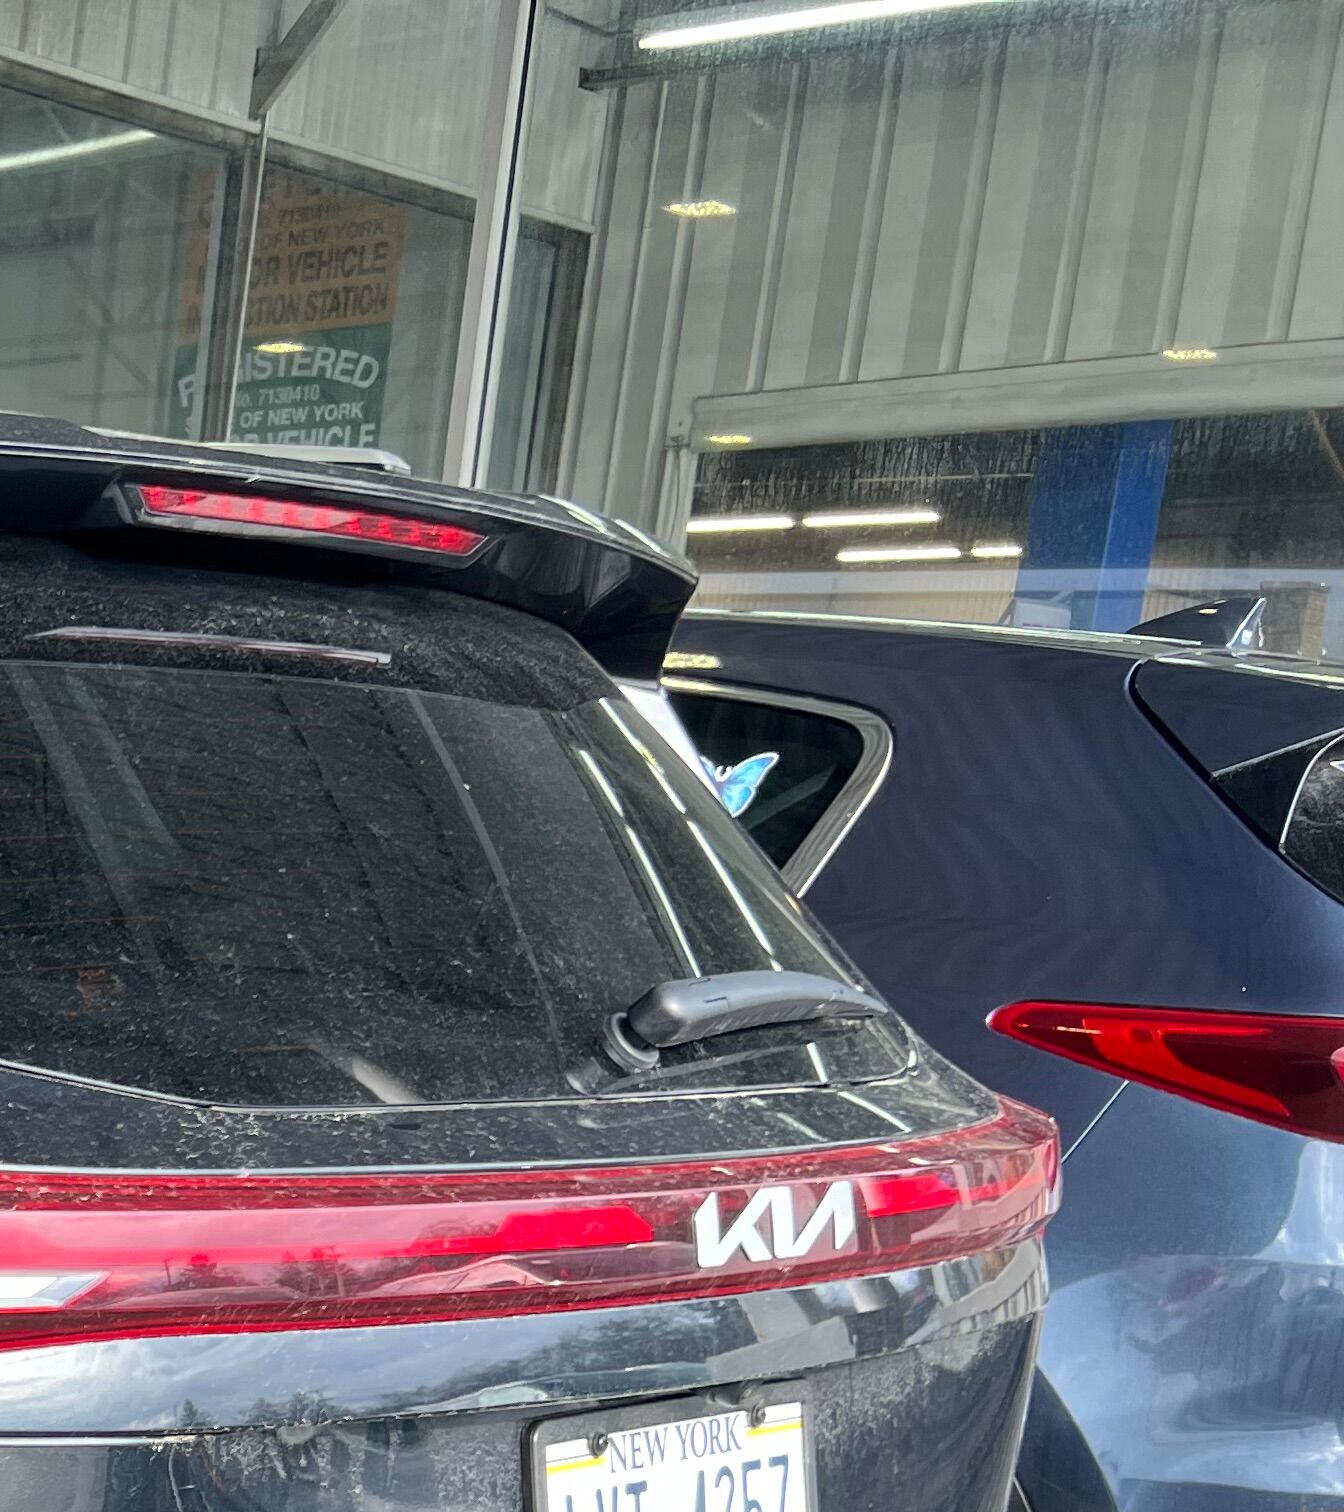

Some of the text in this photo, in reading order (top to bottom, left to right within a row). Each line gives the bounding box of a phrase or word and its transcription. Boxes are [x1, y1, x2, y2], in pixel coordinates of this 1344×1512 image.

[288, 228, 328, 247] NEW
[334, 220, 385, 241] YORK
[287, 242, 389, 285] VEHICLE
[304, 283, 390, 322] STATION
[239, 401, 366, 429] OF NEW YORK
[693, 1180, 857, 1269] KIA
[609, 1414, 742, 1474] NEW YORK
